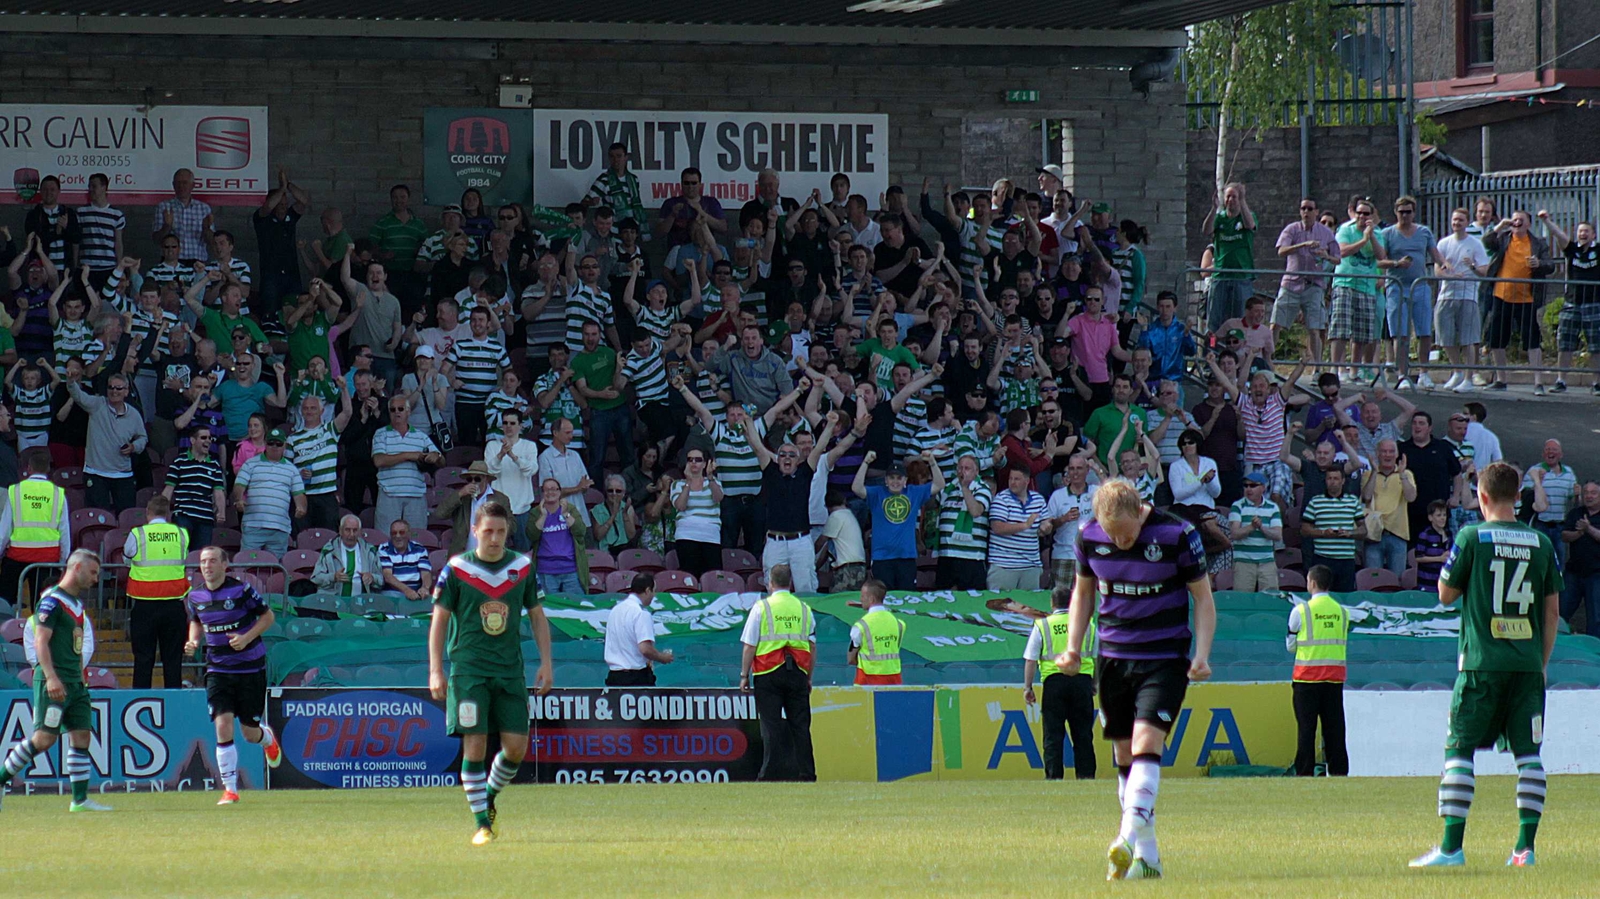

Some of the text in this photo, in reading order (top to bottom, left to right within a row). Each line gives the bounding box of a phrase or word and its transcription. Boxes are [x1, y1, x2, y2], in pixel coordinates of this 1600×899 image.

[43, 116, 164, 149] GALVIN
[550, 120, 875, 173] LOYALTY SCHEME
[57, 155, 131, 168] 023 8820555
[450, 154, 507, 164] CORK CITY
[59, 173, 85, 185] Cork
[115, 174, 136, 185] F.C.
[193, 178, 259, 189] SEAT
[467, 178, 490, 187] 1984
[23, 493, 50, 504] Security
[148, 532, 178, 542] SECURITY
[1494, 530, 1537, 541] EUROMEDIC
[1495, 546, 1531, 559] FURLONG
[1113, 583, 1163, 595] SEAT
[1489, 559, 1534, 615] 14
[775, 614, 801, 626] Security
[1314, 613, 1340, 625] Security
[209, 622, 240, 633] SEAT
[874, 635, 898, 645] Security
[286, 703, 423, 716] PADRAIG HORGAN
[528, 693, 760, 721] NGTH & CONDITIONI
[302, 717, 430, 758] PHSC
[531, 735, 734, 756] FITNESS STUDIO
[303, 762, 427, 771] STRENGTH & CONDITIONING
[342, 775, 455, 788] FITNESS STUDIO
[555, 769, 604, 785] 085
